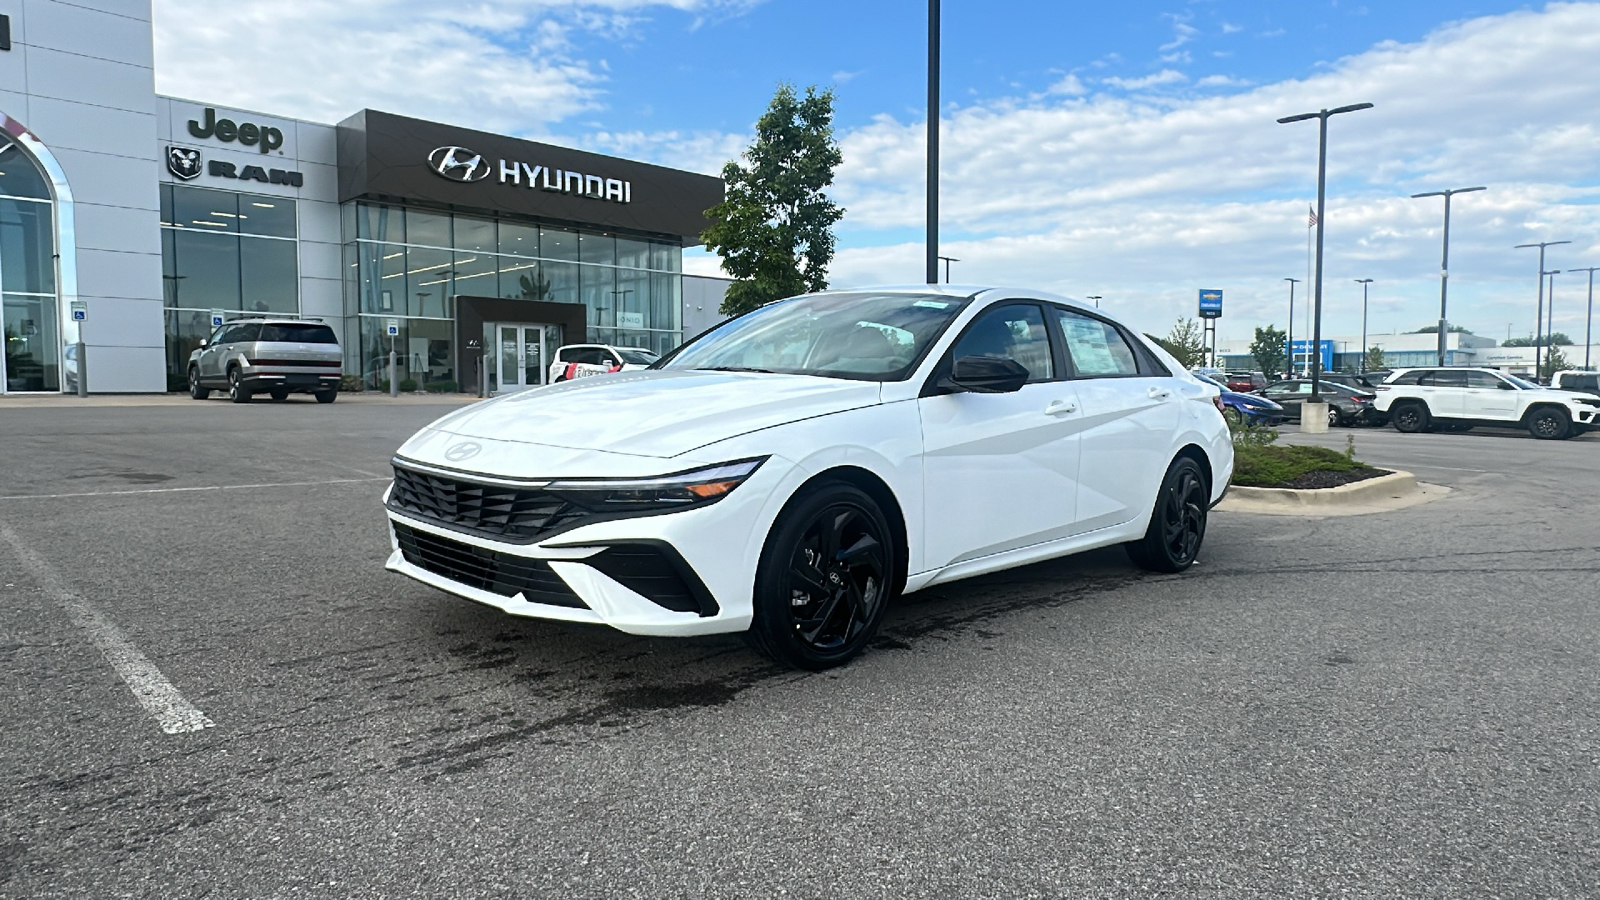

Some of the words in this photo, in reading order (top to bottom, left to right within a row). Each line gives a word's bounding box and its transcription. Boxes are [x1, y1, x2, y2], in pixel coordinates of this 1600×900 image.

[188, 107, 283, 154] Jeep
[208, 160, 303, 187] RAM
[499, 159, 631, 203] HYUNDAI
